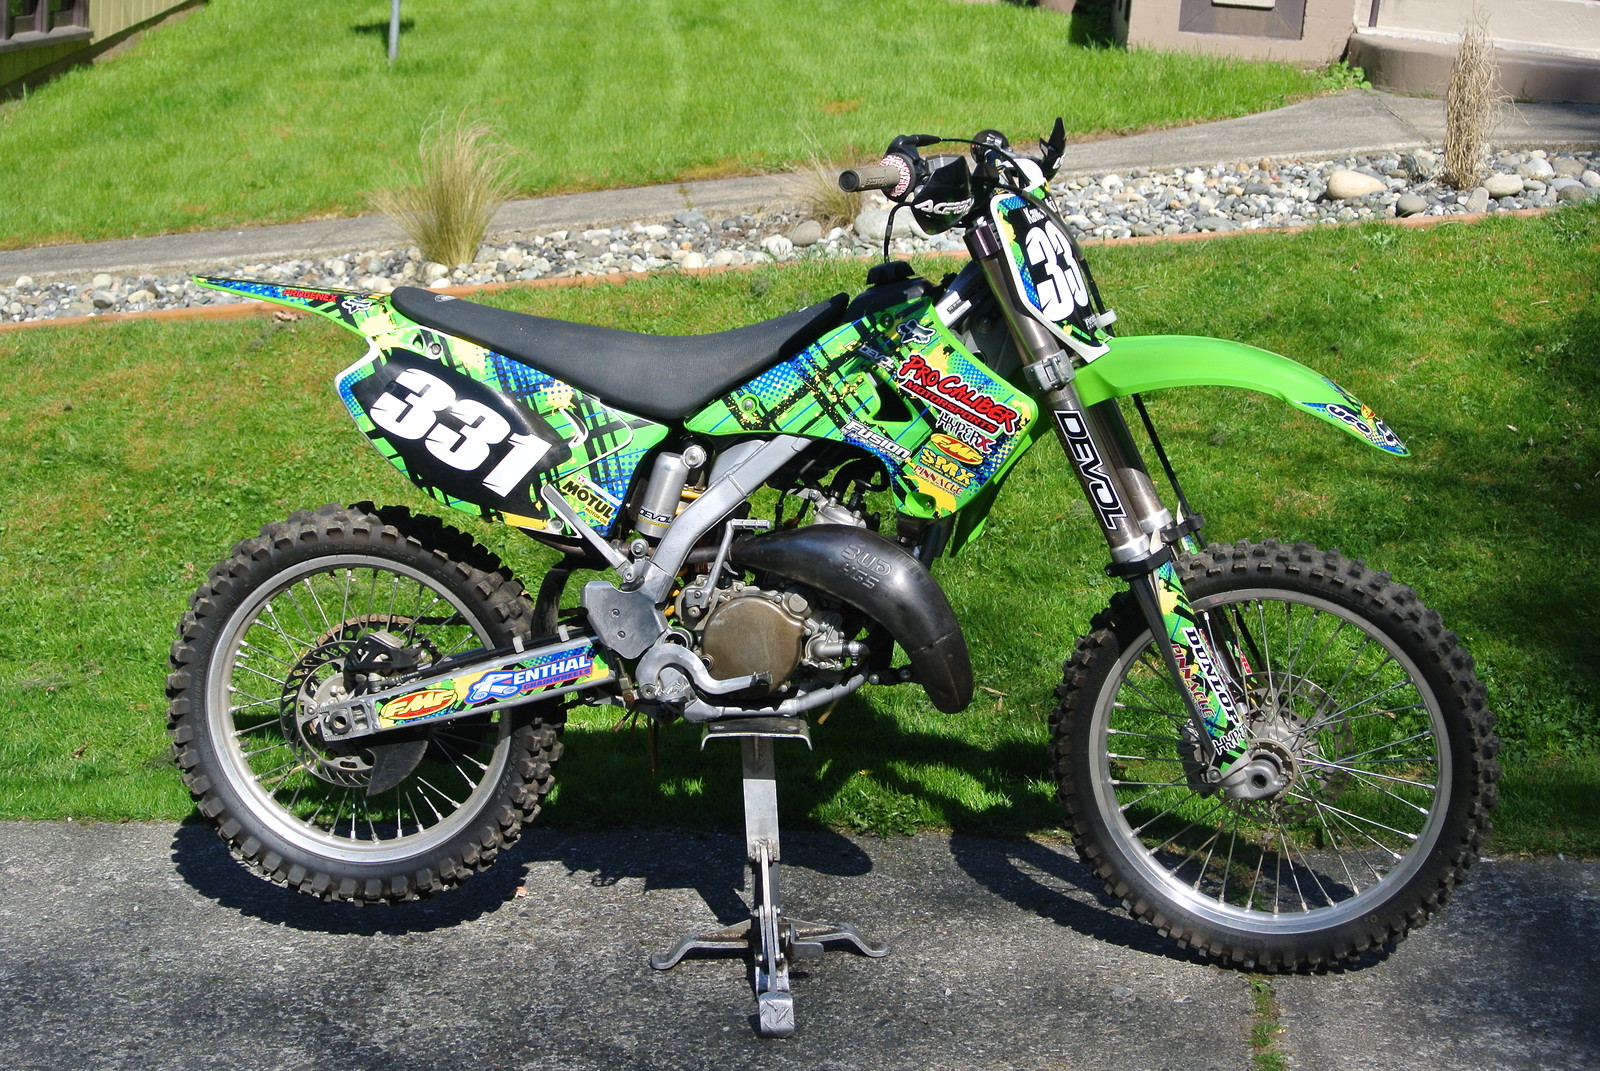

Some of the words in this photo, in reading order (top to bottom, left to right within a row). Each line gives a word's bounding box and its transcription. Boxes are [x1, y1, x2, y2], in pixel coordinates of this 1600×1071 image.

[899, 354, 940, 387] PRO
[937, 376, 1017, 433] CALIBER
[903, 380, 999, 433] MOTORSPORTS
[370, 368, 552, 498] 331
[931, 433, 983, 465] FMF
[914, 465, 964, 494] PINNACLE
[1054, 410, 1127, 530] DEVOL
[562, 480, 613, 519] MOTUL
[383, 689, 456, 718] FMF
[523, 668, 591, 690] CHAINWHEELS
[1172, 644, 1215, 718] PINNACLE
[1186, 629, 1241, 726] DUNLOP
